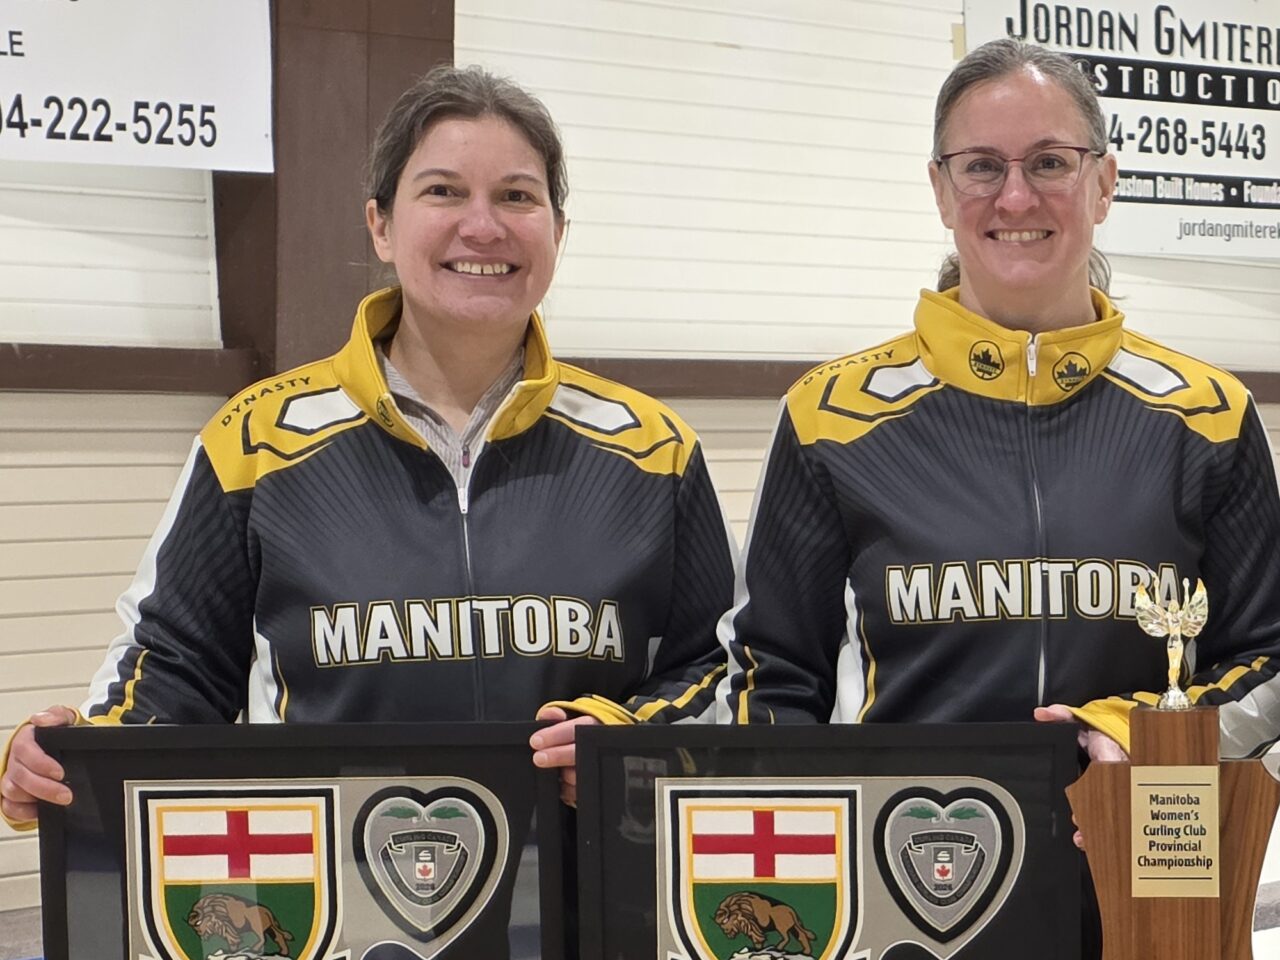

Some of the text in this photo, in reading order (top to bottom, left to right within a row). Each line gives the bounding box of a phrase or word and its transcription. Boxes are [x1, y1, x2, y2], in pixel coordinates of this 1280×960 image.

[1005, 0, 1139, 53] JORDAN
[0, 93, 217, 148] 4-222-5255
[1108, 113, 1266, 160] 4-268-5443
[1156, 176, 1184, 199] Built
[1185, 178, 1225, 202] Homes
[803, 349, 894, 386] DYNASTY
[220, 376, 311, 427] DYNASTY
[886, 558, 1183, 625] MANITOBA
[310, 596, 625, 668] MANITOBA
[1149, 793, 1200, 806] Manitoba
[1150, 809, 1199, 821] Women's
[1143, 824, 1206, 839] Curling Club
[1148, 840, 1202, 851] Provincial
[1137, 855, 1213, 870] Championship
